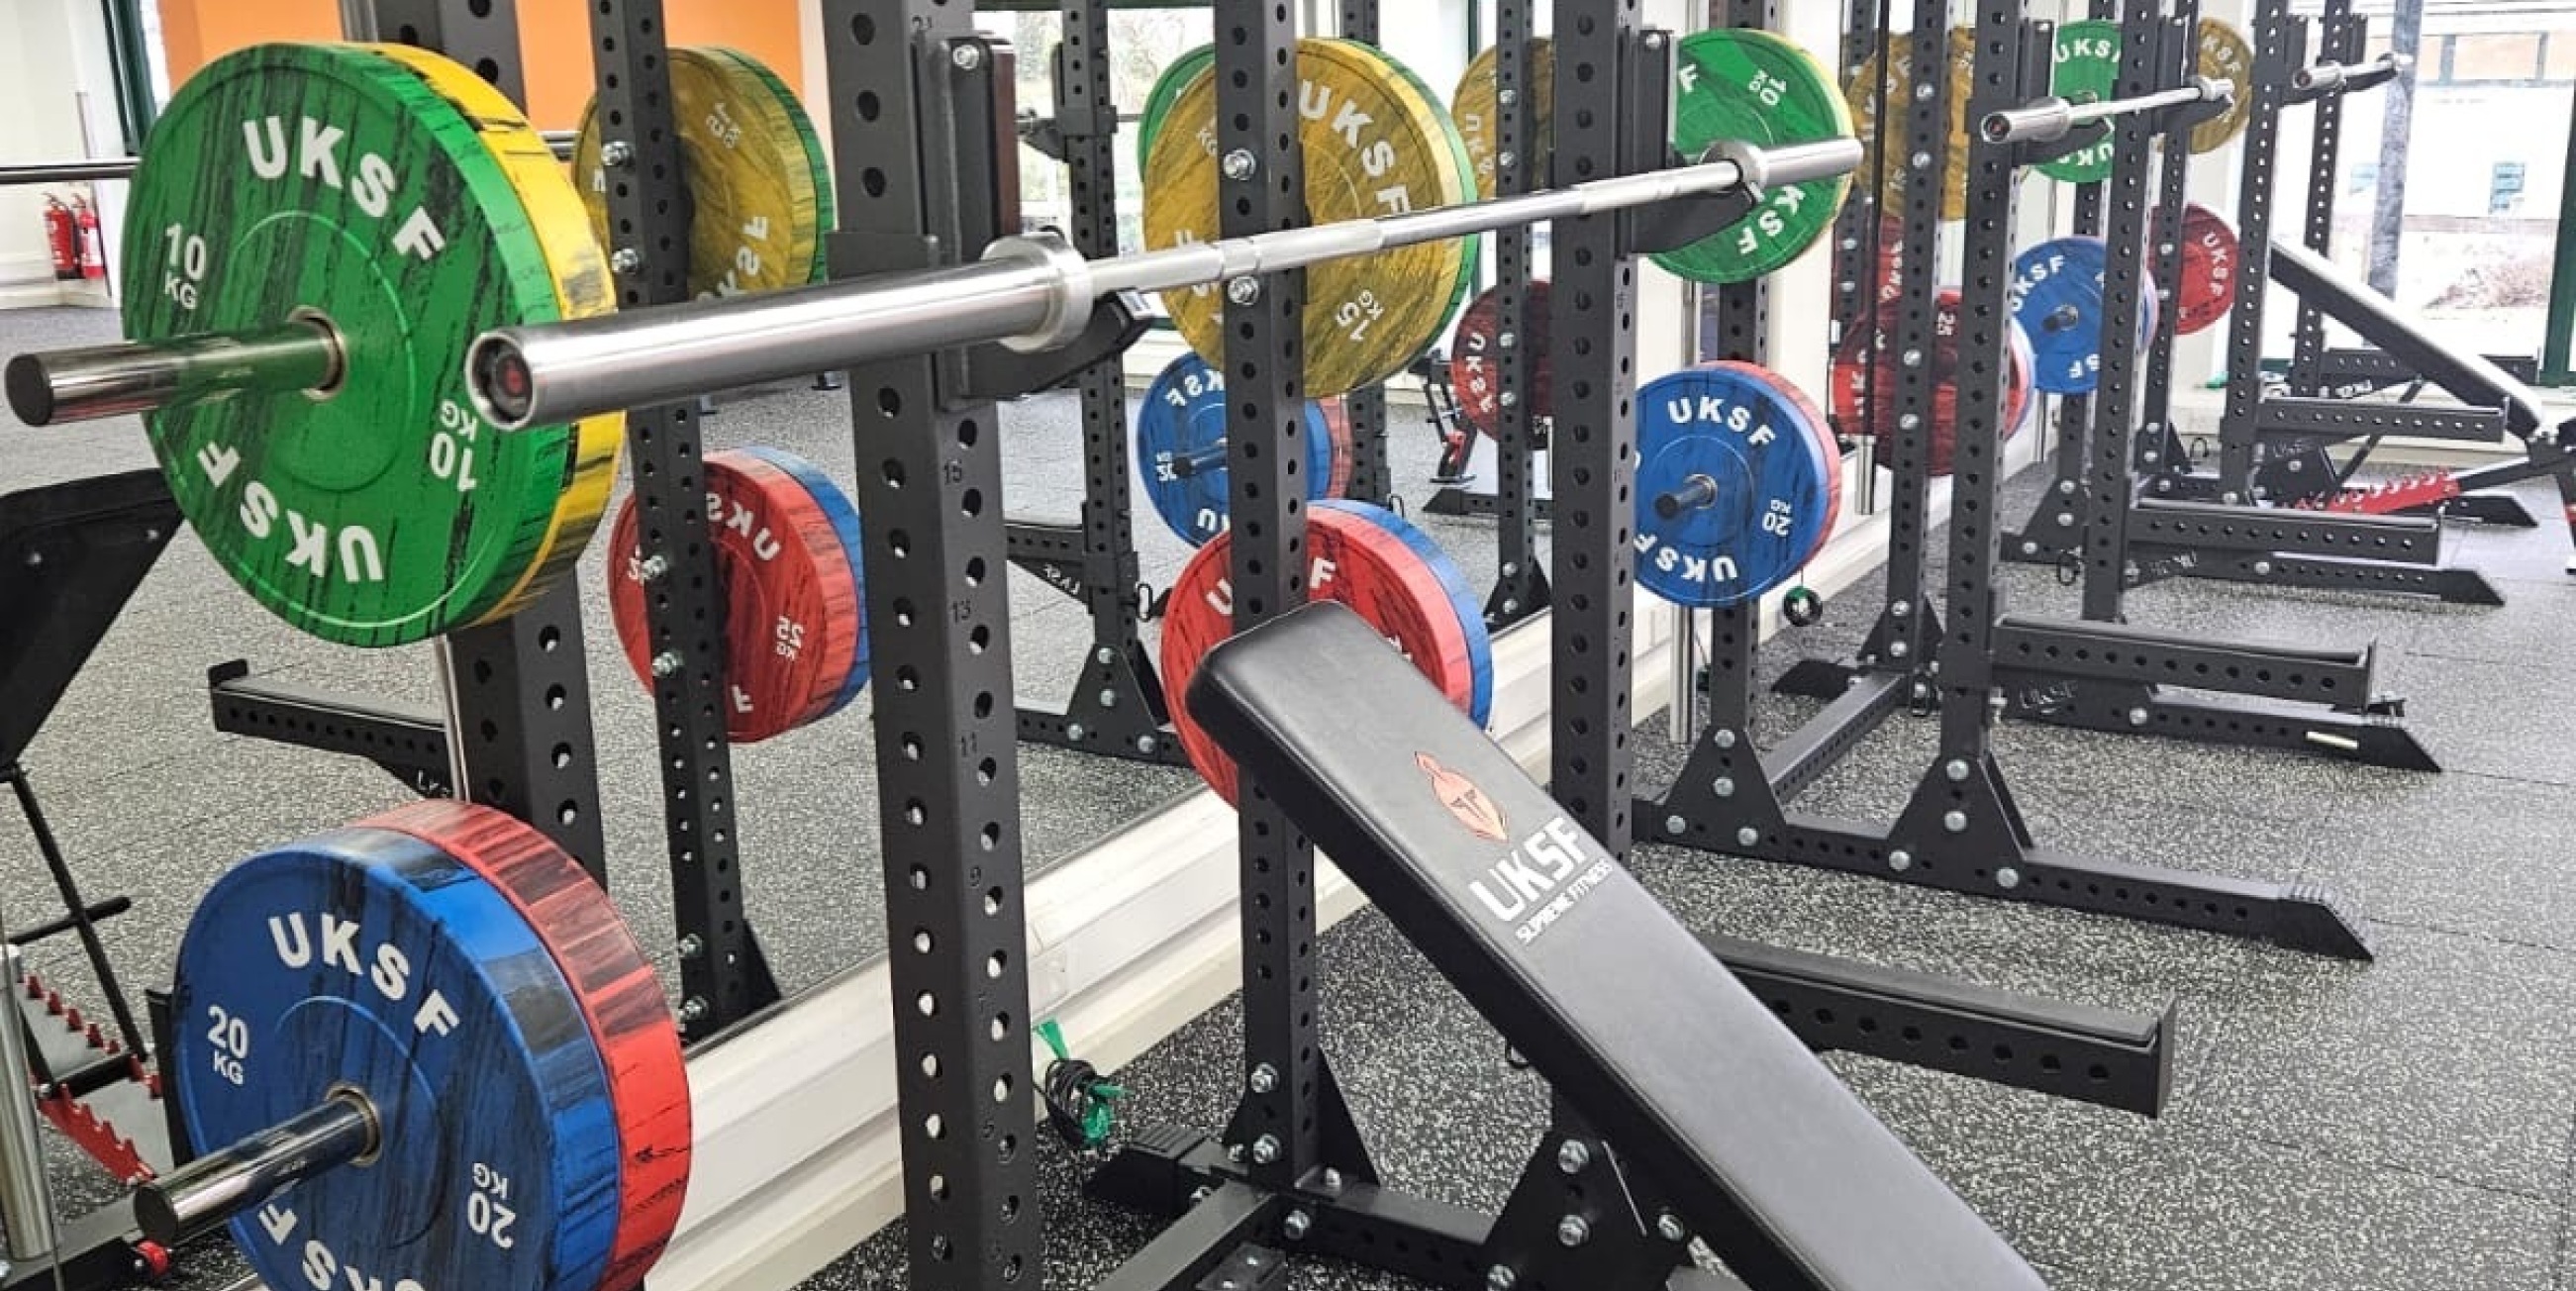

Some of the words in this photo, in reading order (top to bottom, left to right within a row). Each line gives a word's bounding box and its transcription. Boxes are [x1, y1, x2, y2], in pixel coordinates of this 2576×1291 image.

[1759, 75, 1788, 106] 10
[1299, 80, 1411, 216] UKSF
[243, 115, 445, 261] UKSF
[164, 224, 207, 281] 10
[163, 274, 198, 311] KG
[1337, 301, 1369, 342] 15
[439, 399, 478, 440] KG
[1668, 397, 1777, 447] UKSF
[430, 433, 478, 494] 10
[197, 441, 384, 583] UKSF
[1762, 514, 1793, 536] 20
[1770, 499, 1793, 517] KG
[1634, 534, 1738, 583] UKSF
[1469, 817, 1586, 922] UKSF
[268, 913, 458, 1037] UKSF
[207, 1005, 249, 1059] 20
[213, 1054, 245, 1085] KG
[472, 1161, 508, 1200] KG
[467, 1191, 517, 1249] 20
